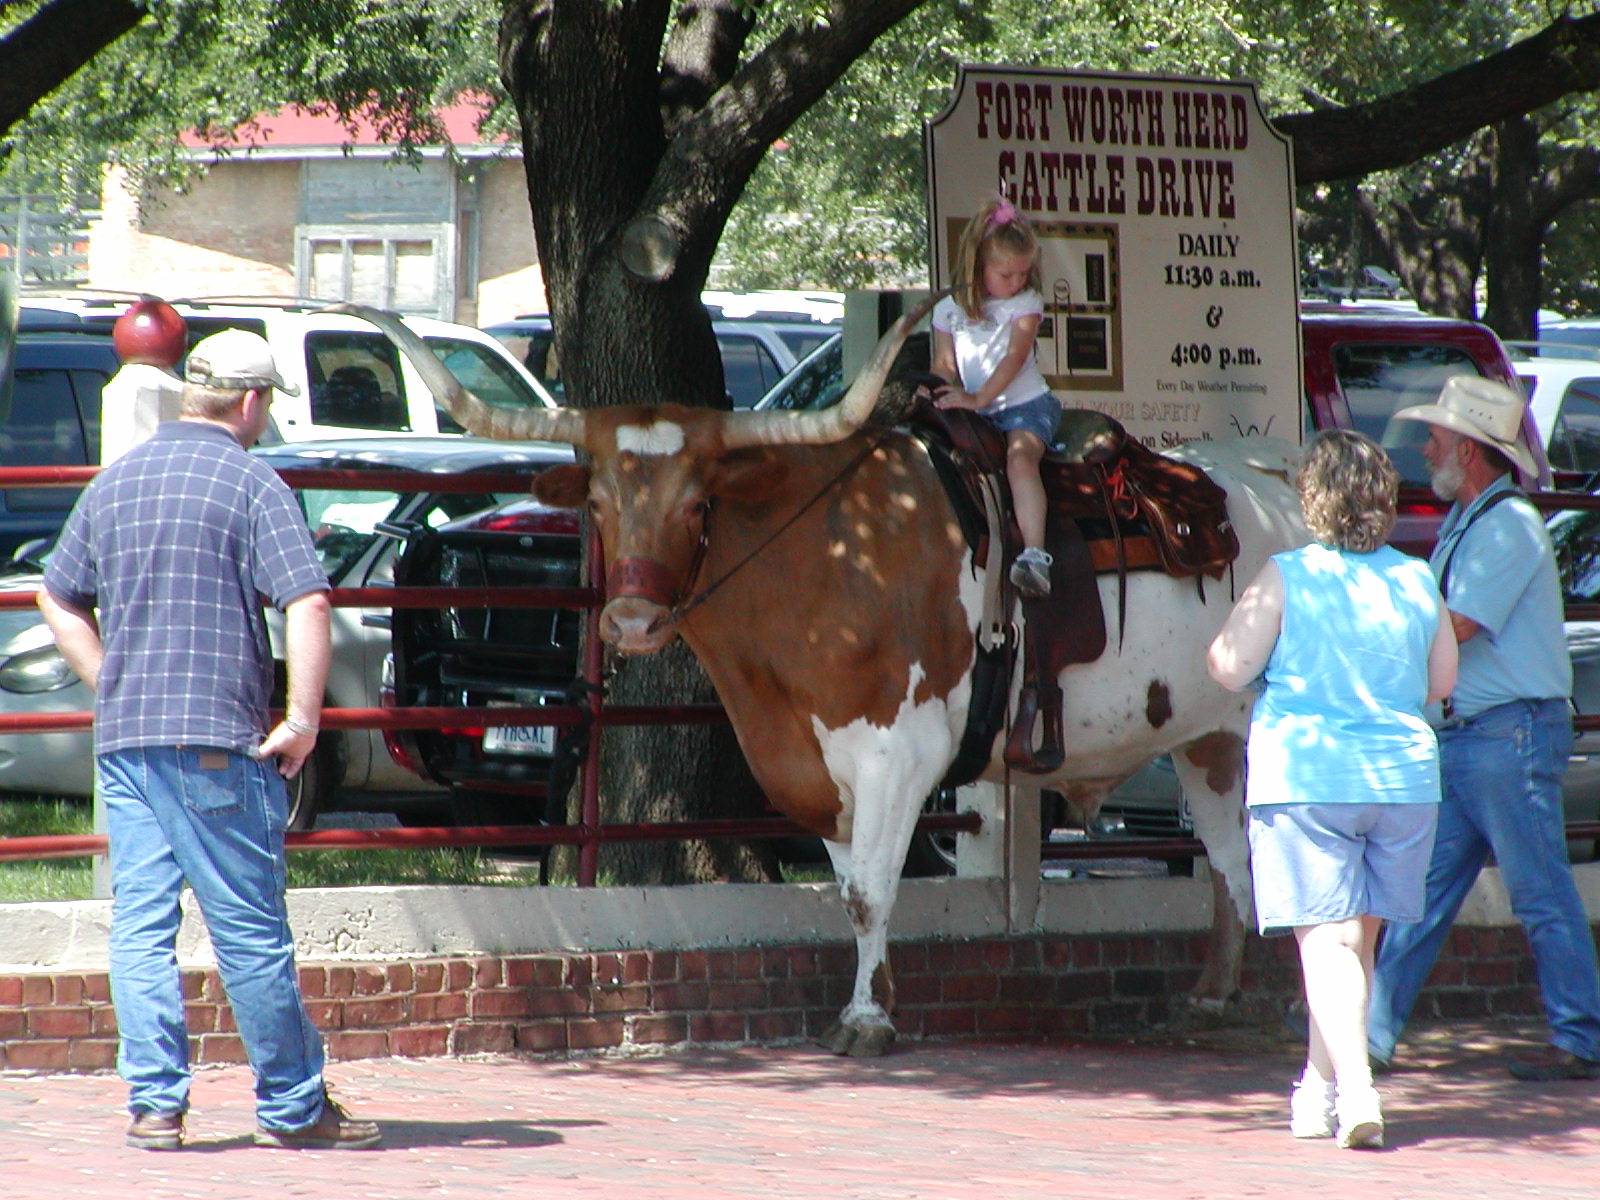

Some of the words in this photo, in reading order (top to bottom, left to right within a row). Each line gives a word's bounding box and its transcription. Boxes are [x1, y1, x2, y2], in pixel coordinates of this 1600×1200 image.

[975, 81, 1053, 140] FORT
[1062, 85, 1165, 146] WORTH
[1173, 91, 1249, 150] HERD
[999, 150, 1126, 214] CATTLE
[1136, 156, 1236, 219] DRIVE
[1178, 233, 1240, 258] DAILY
[1164, 264, 1213, 289] 11:30
[1220, 268, 1261, 288] a.m.
[1206, 305, 1223, 328] &
[1171, 343, 1212, 367] 4:00
[1219, 347, 1262, 370] p.m.
[1156, 379, 1177, 392] Every
[1180, 380, 1195, 394] Day
[1197, 380, 1228, 392] Weather
[1141, 401, 1201, 422] SAFETY
